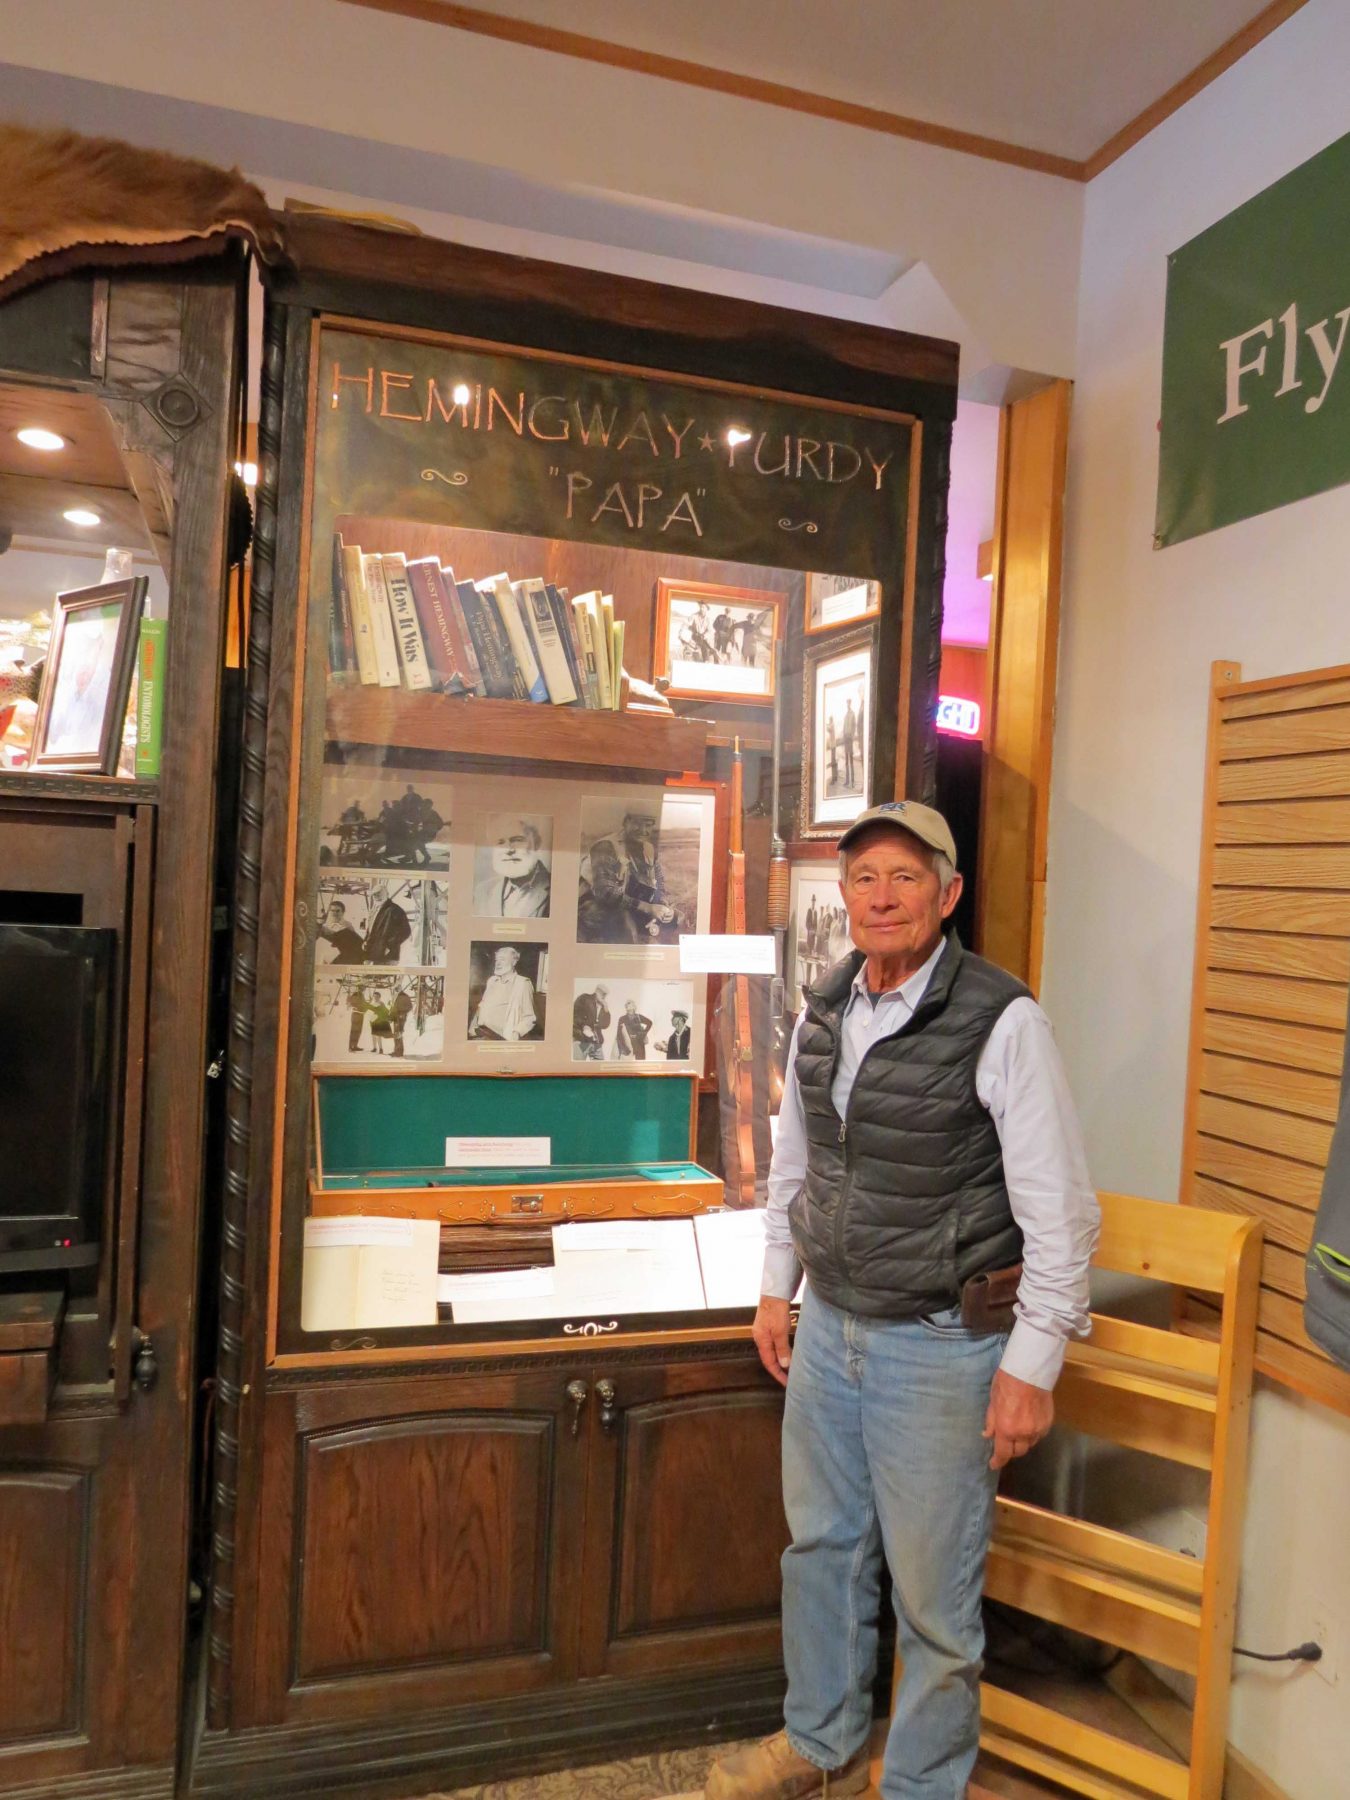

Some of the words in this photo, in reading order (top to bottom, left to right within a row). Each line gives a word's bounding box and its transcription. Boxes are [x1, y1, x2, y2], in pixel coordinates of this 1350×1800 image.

[1216, 302, 1350, 425] Fly
[331, 362, 695, 460] HEMINGWAY
[391, 578, 409, 614] How
[399, 617, 414, 630] It
[401, 630, 420, 663] Was
[433, 600, 454, 657] HEMINGWAY
